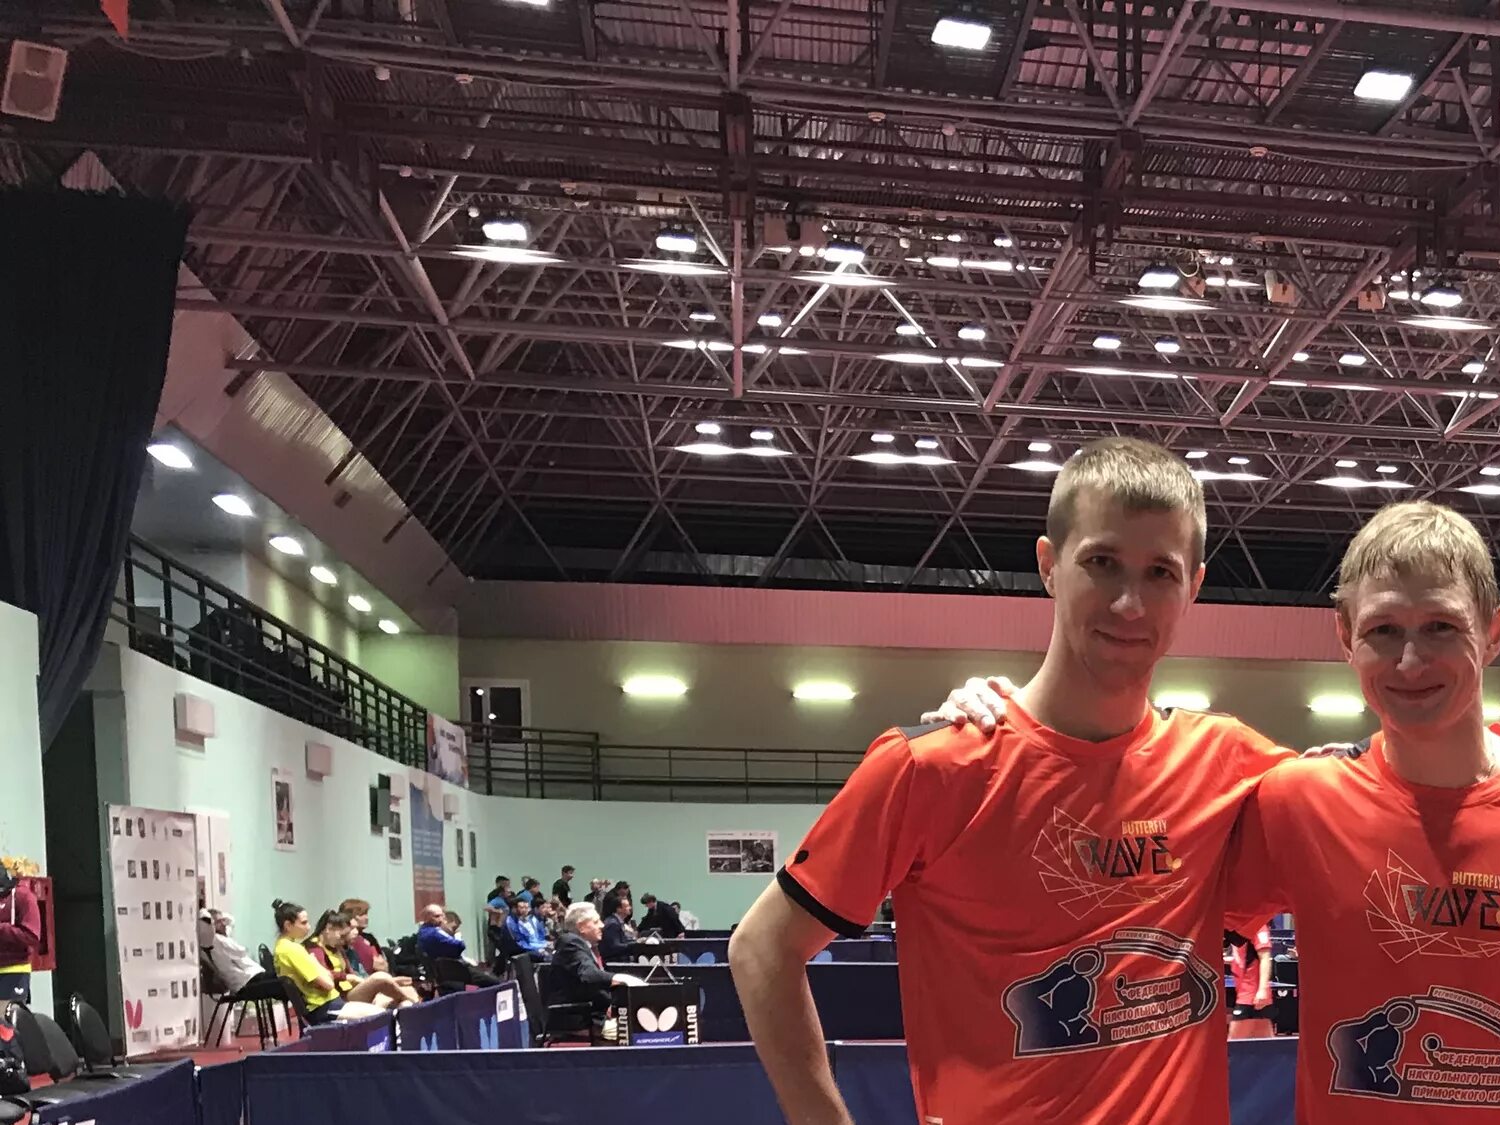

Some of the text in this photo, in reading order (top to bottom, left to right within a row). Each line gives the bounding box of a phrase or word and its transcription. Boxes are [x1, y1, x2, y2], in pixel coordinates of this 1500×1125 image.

[1121, 818, 1167, 835] BUTTERFLY
[1073, 836, 1173, 879] WAVE
[1407, 1068, 1480, 1085] НАСТОЛЬНОГО
[1412, 1085, 1486, 1102] ПРИМОРСКОГО
